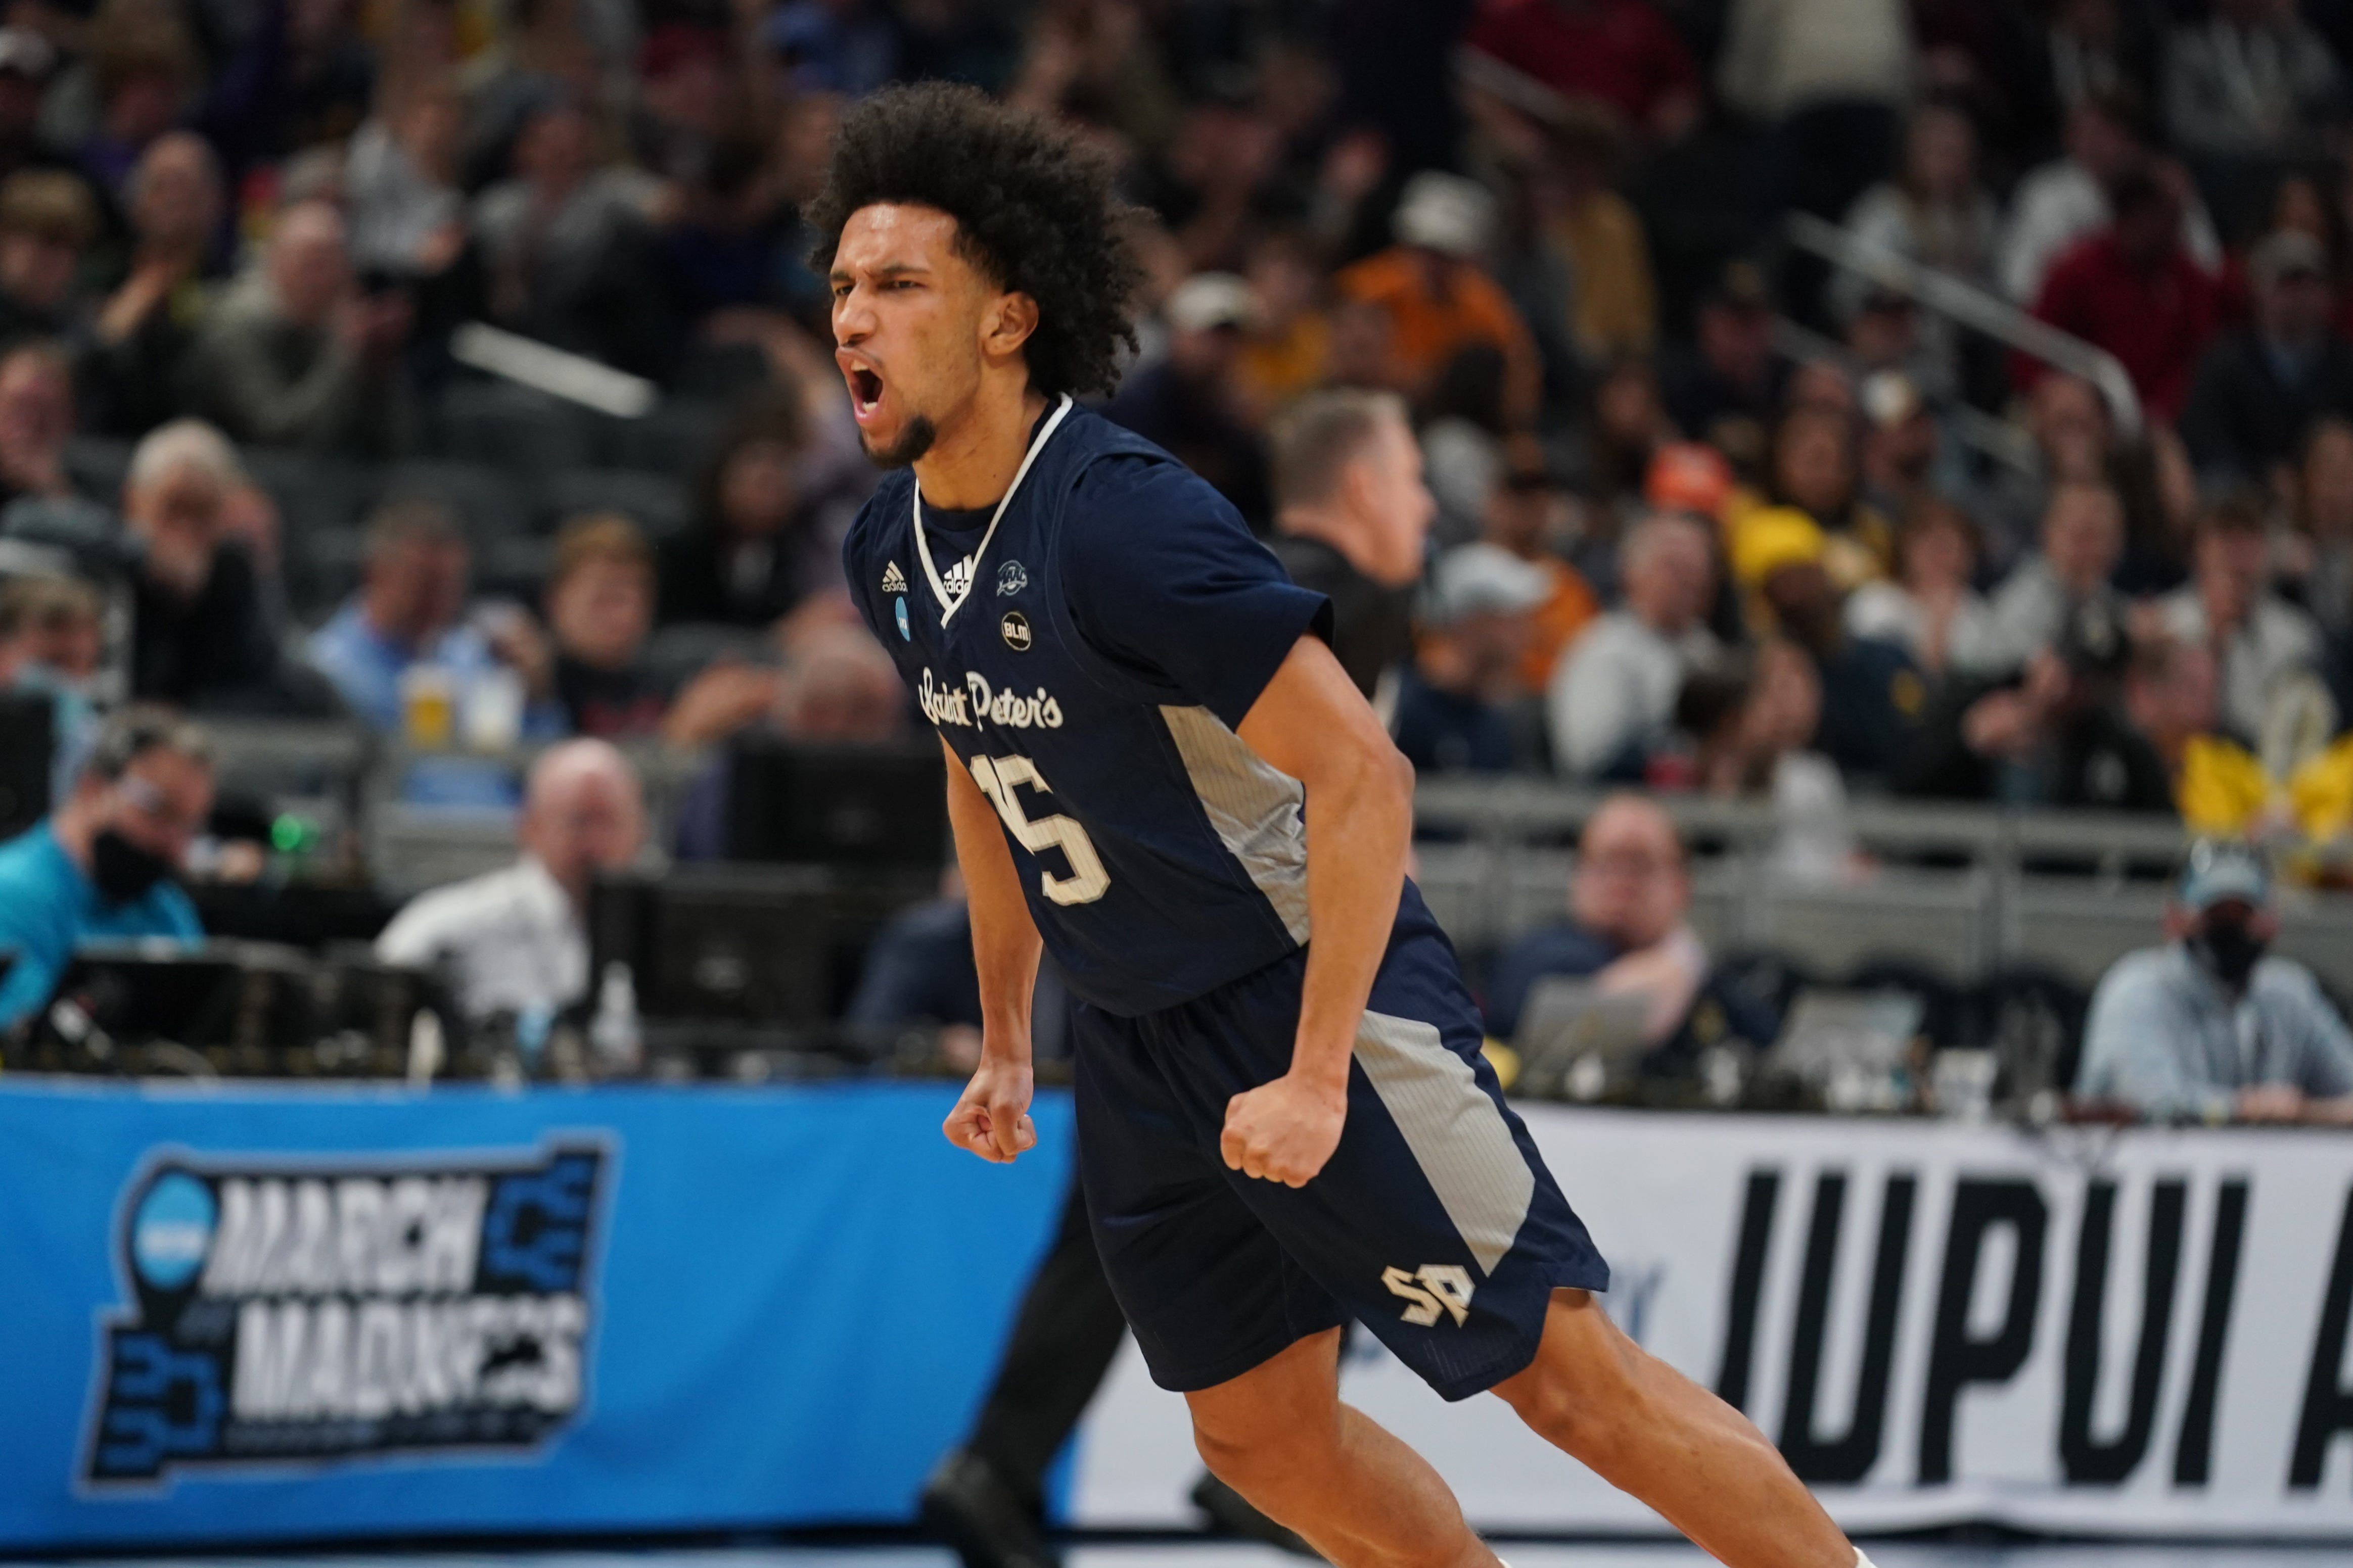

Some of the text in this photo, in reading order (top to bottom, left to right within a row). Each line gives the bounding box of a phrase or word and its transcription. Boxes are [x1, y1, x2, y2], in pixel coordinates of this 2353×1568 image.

[882, 581, 908, 593] adida
[1004, 622, 1029, 641] BLM
[918, 666, 1064, 733] Saint Peter's
[969, 754, 1111, 907] 15
[203, 1176, 490, 1297] MARCH
[1711, 1167, 2252, 1487] IUPUI
